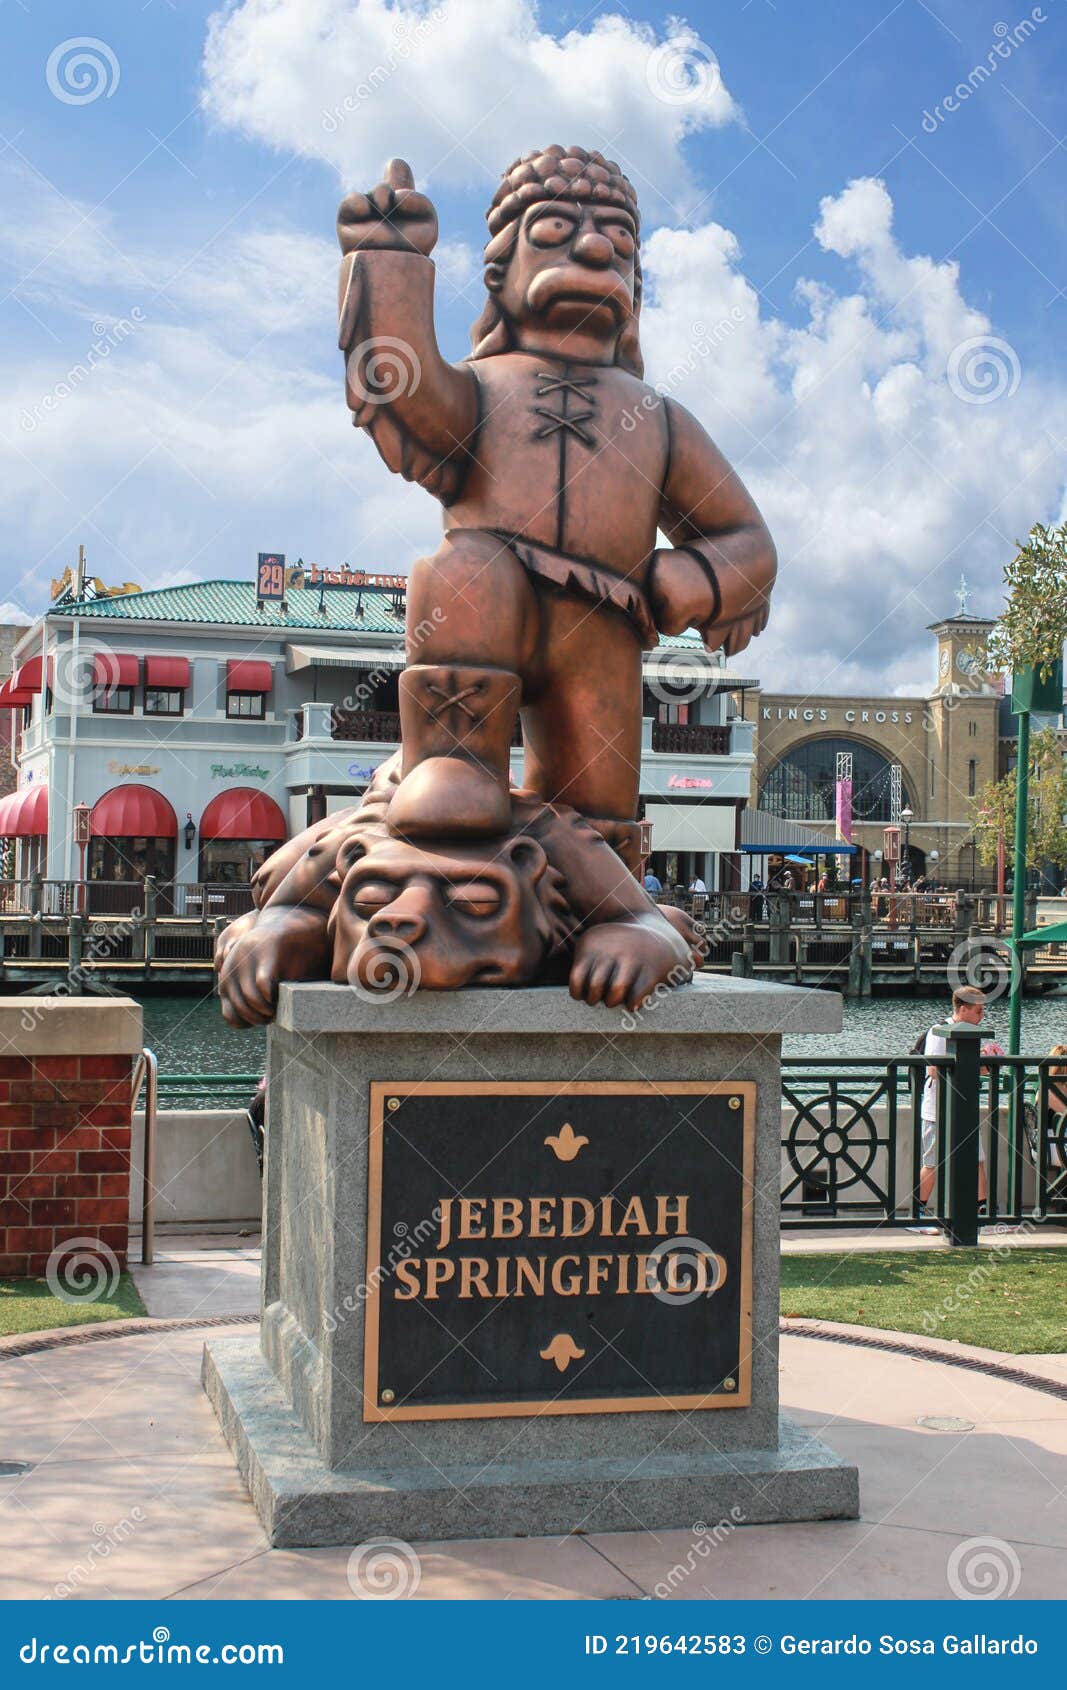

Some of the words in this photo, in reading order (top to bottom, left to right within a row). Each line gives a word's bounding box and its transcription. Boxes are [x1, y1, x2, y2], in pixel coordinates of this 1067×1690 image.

[763, 708, 828, 721] KING'S
[845, 710, 912, 723] CROSS
[436, 1195, 689, 1250] JEBEDIAH
[394, 1252, 728, 1301] SPRINGFIELD
